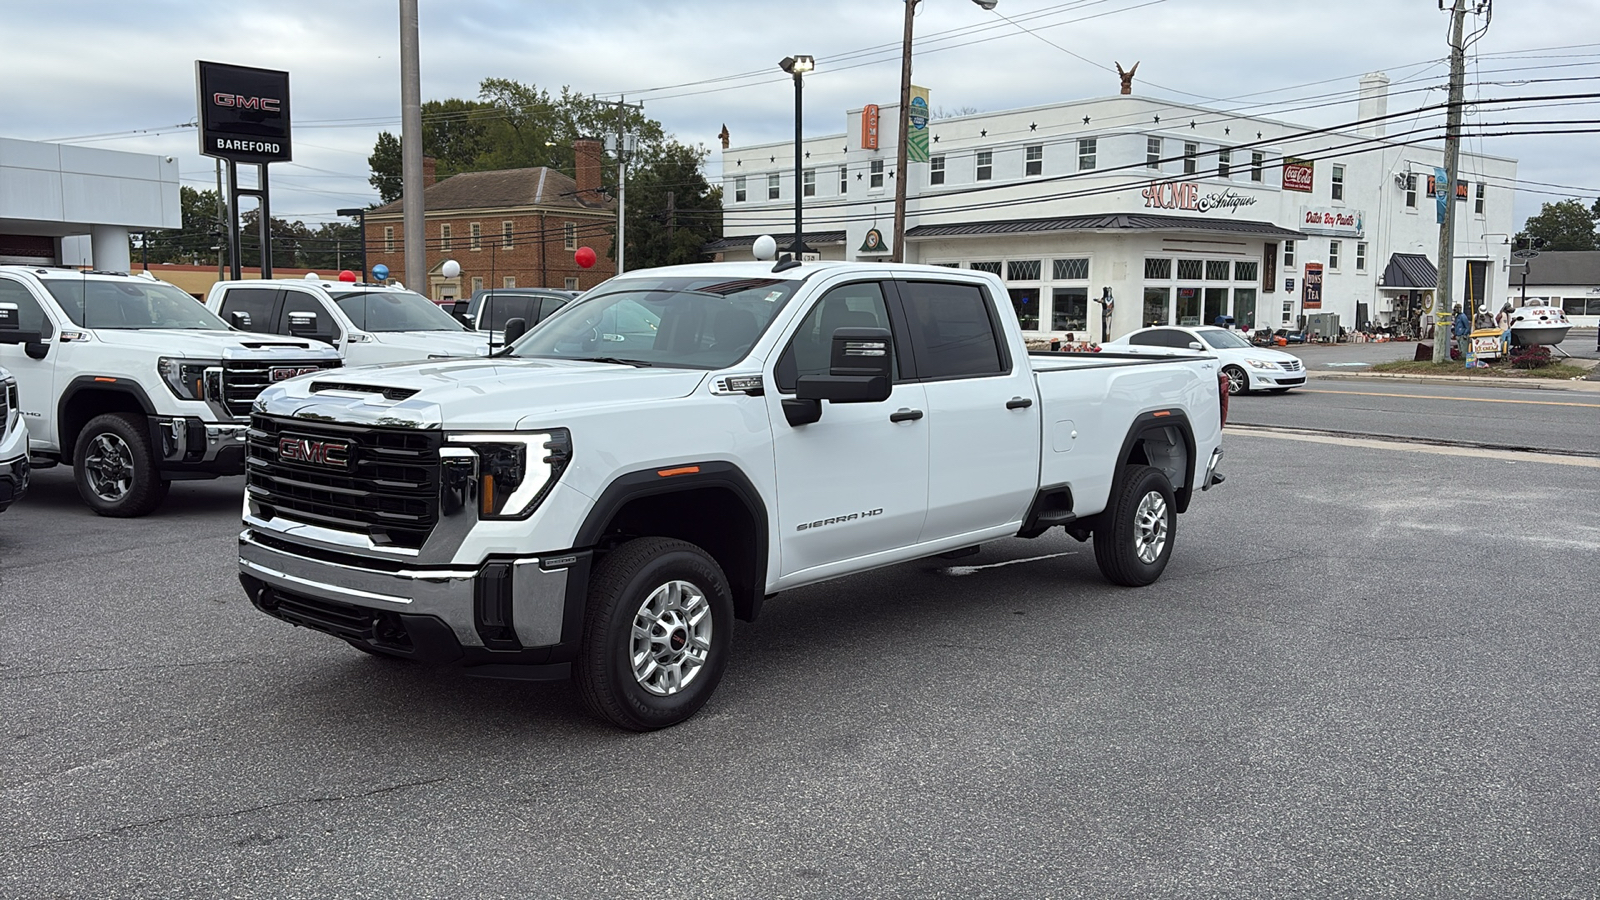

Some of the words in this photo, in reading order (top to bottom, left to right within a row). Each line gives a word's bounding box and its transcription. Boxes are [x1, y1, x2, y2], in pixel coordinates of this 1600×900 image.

[213, 92, 281, 112] GMC
[869, 107, 877, 146] ACME
[216, 138, 280, 154] BAREFORD
[1141, 180, 1199, 211] ACME
[1198, 186, 1257, 214] Antiques
[1305, 211, 1323, 224] Dutch
[1324, 212, 1336, 228] Boy
[1335, 213, 1354, 226] Paints
[1307, 288, 1320, 300] TEA
[279, 437, 348, 467] GMC
[796, 513, 858, 531] SIERRA
[861, 508, 884, 518] HD
